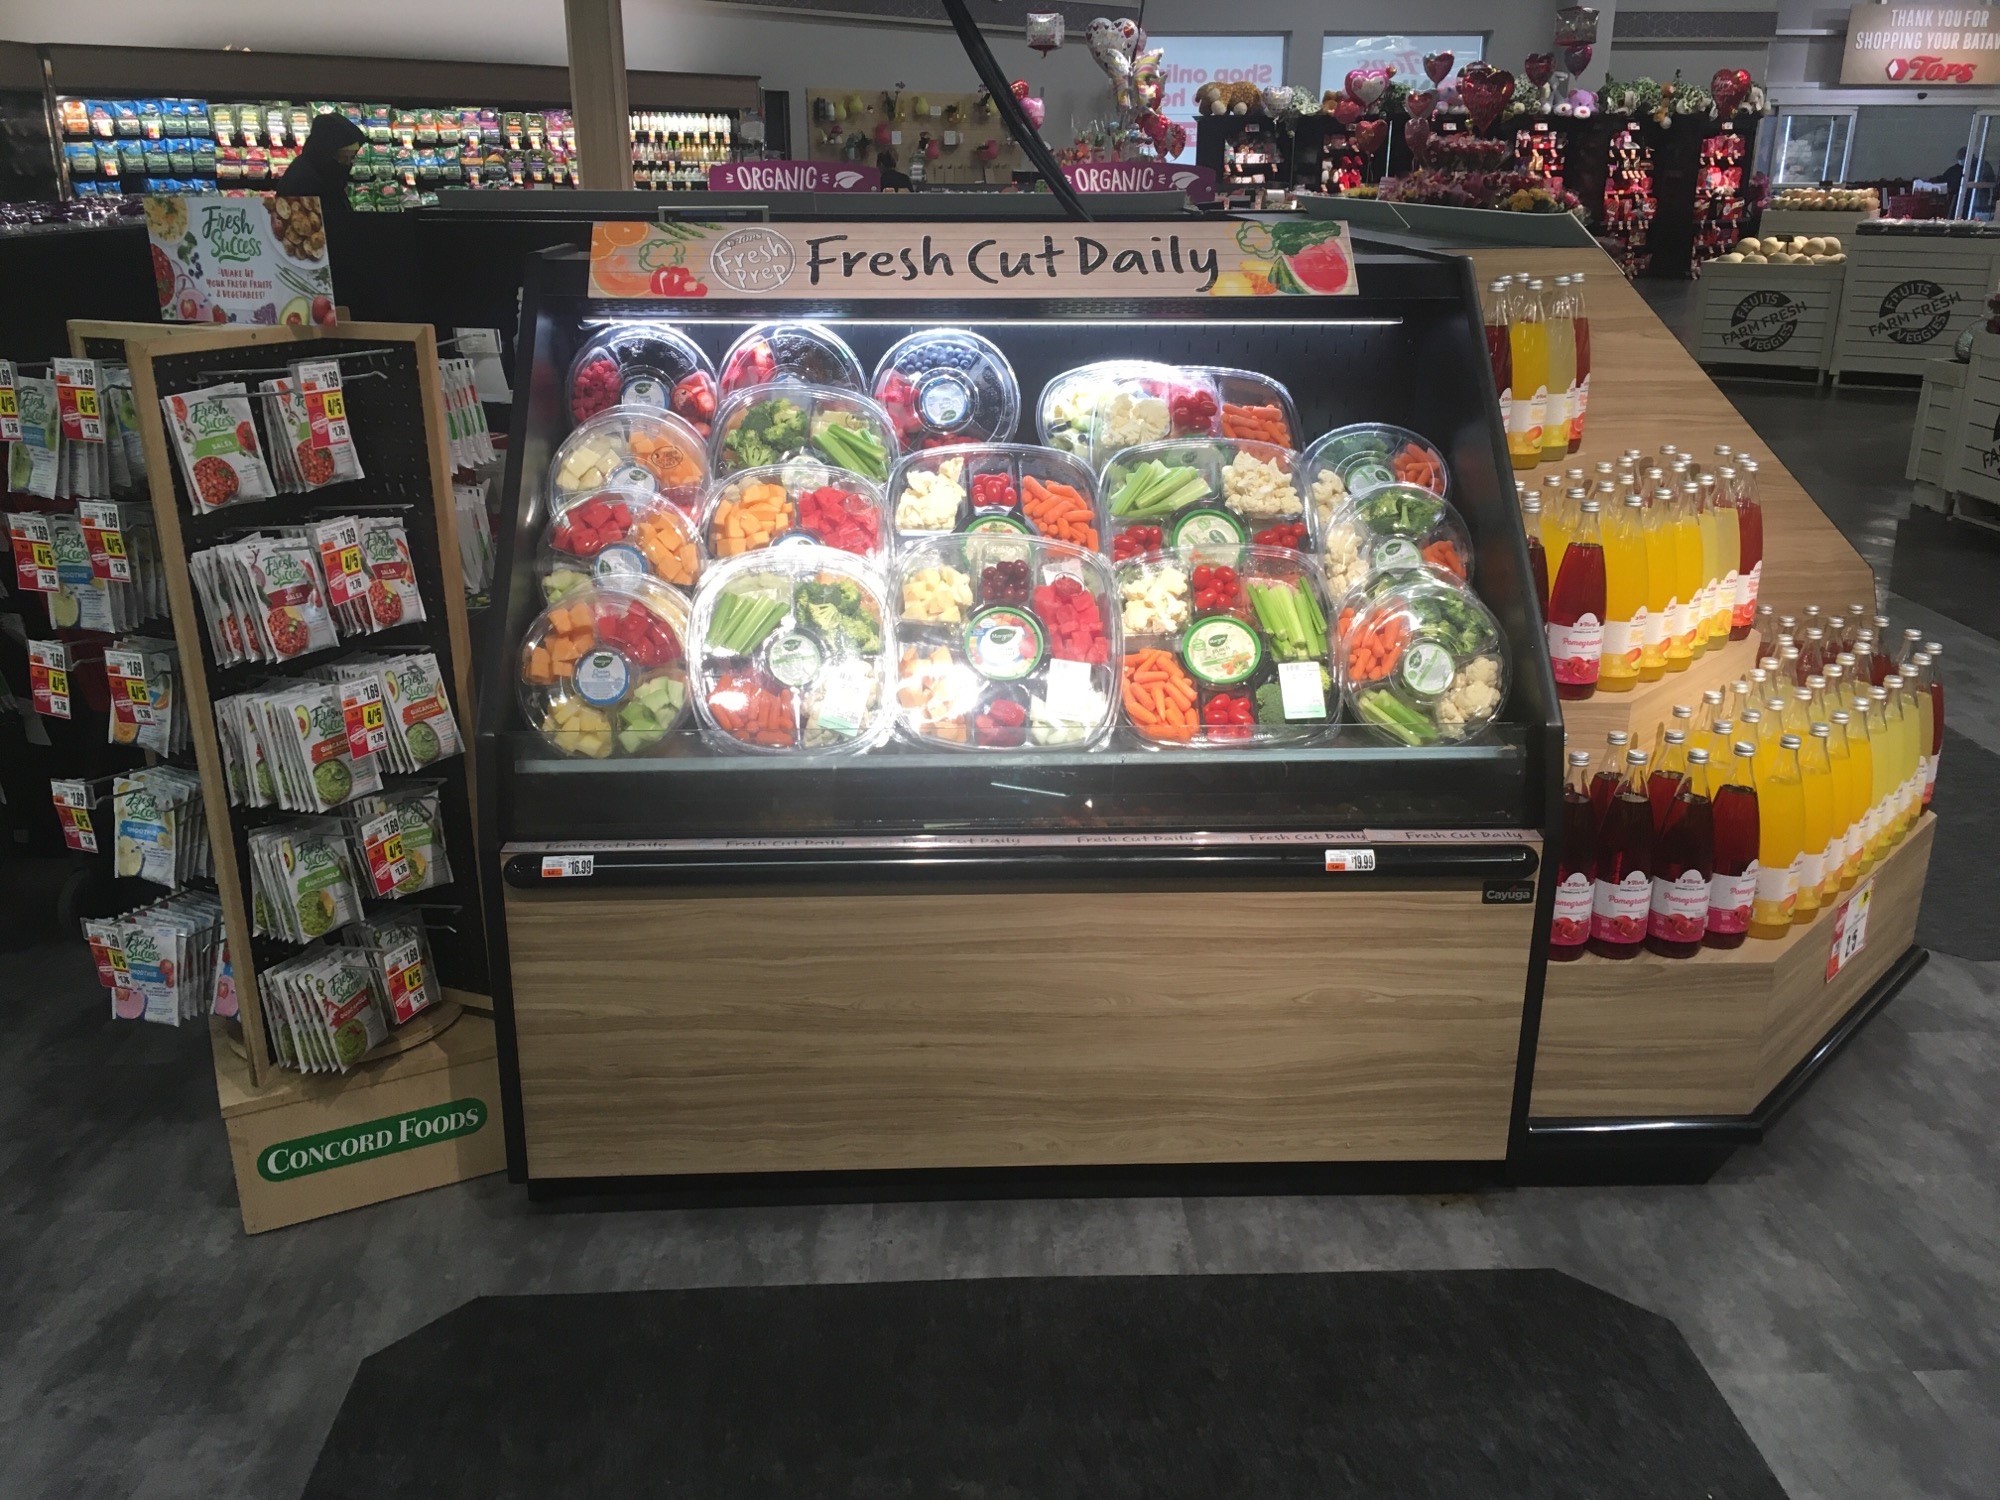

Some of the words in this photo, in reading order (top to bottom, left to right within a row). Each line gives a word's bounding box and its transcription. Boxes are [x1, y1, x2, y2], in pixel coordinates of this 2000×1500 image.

[1891, 9, 1935, 27] THANK
[1937, 10, 1964, 28] YOU
[1964, 10, 1989, 28] FOR
[1856, 32, 1923, 50] SHOPPING
[1927, 32, 1960, 50] YOUR
[737, 166, 817, 191] ORGANIC
[1075, 167, 1154, 192] ORGANIC
[202, 205, 255, 238] Fresh
[211, 229, 262, 258] Success
[715, 236, 787, 276] Fresh
[220, 268, 242, 278] WAKE
[806, 235, 954, 285] Fresh
[967, 235, 1065, 285] Cut
[1074, 235, 1218, 292] Daily
[206, 279, 225, 288] YOUR
[227, 279, 248, 288] FRESH
[250, 280, 272, 289] FRUITS
[1885, 282, 1931, 310] FRUITS
[1735, 292, 1779, 319] FRUITS
[1868, 313, 1910, 337] FARM
[1913, 292, 1962, 320] FRESH
[1722, 324, 1759, 345] FARM
[1762, 301, 1807, 328] FRESH
[1896, 313, 1946, 343] VEGGIES
[1749, 323, 1794, 352] VEGGIES
[1076, 835, 1117, 843] Fresh
[1154, 835, 1194, 843] Daily
[1249, 833, 1290, 841] Fresh
[1295, 833, 1321, 841] Cut
[1325, 832, 1366, 841] Daily
[1405, 831, 1446, 840] Fresh
[1450, 831, 1478, 839] Cut
[1481, 831, 1522, 840] Daily
[568, 859, 592, 875] $16.99
[1352, 854, 1374, 870] $19.99
[1486, 890, 1530, 900] Cayuga
[267, 1130, 393, 1174] CONCORD
[398, 1108, 479, 1144] FOODS
